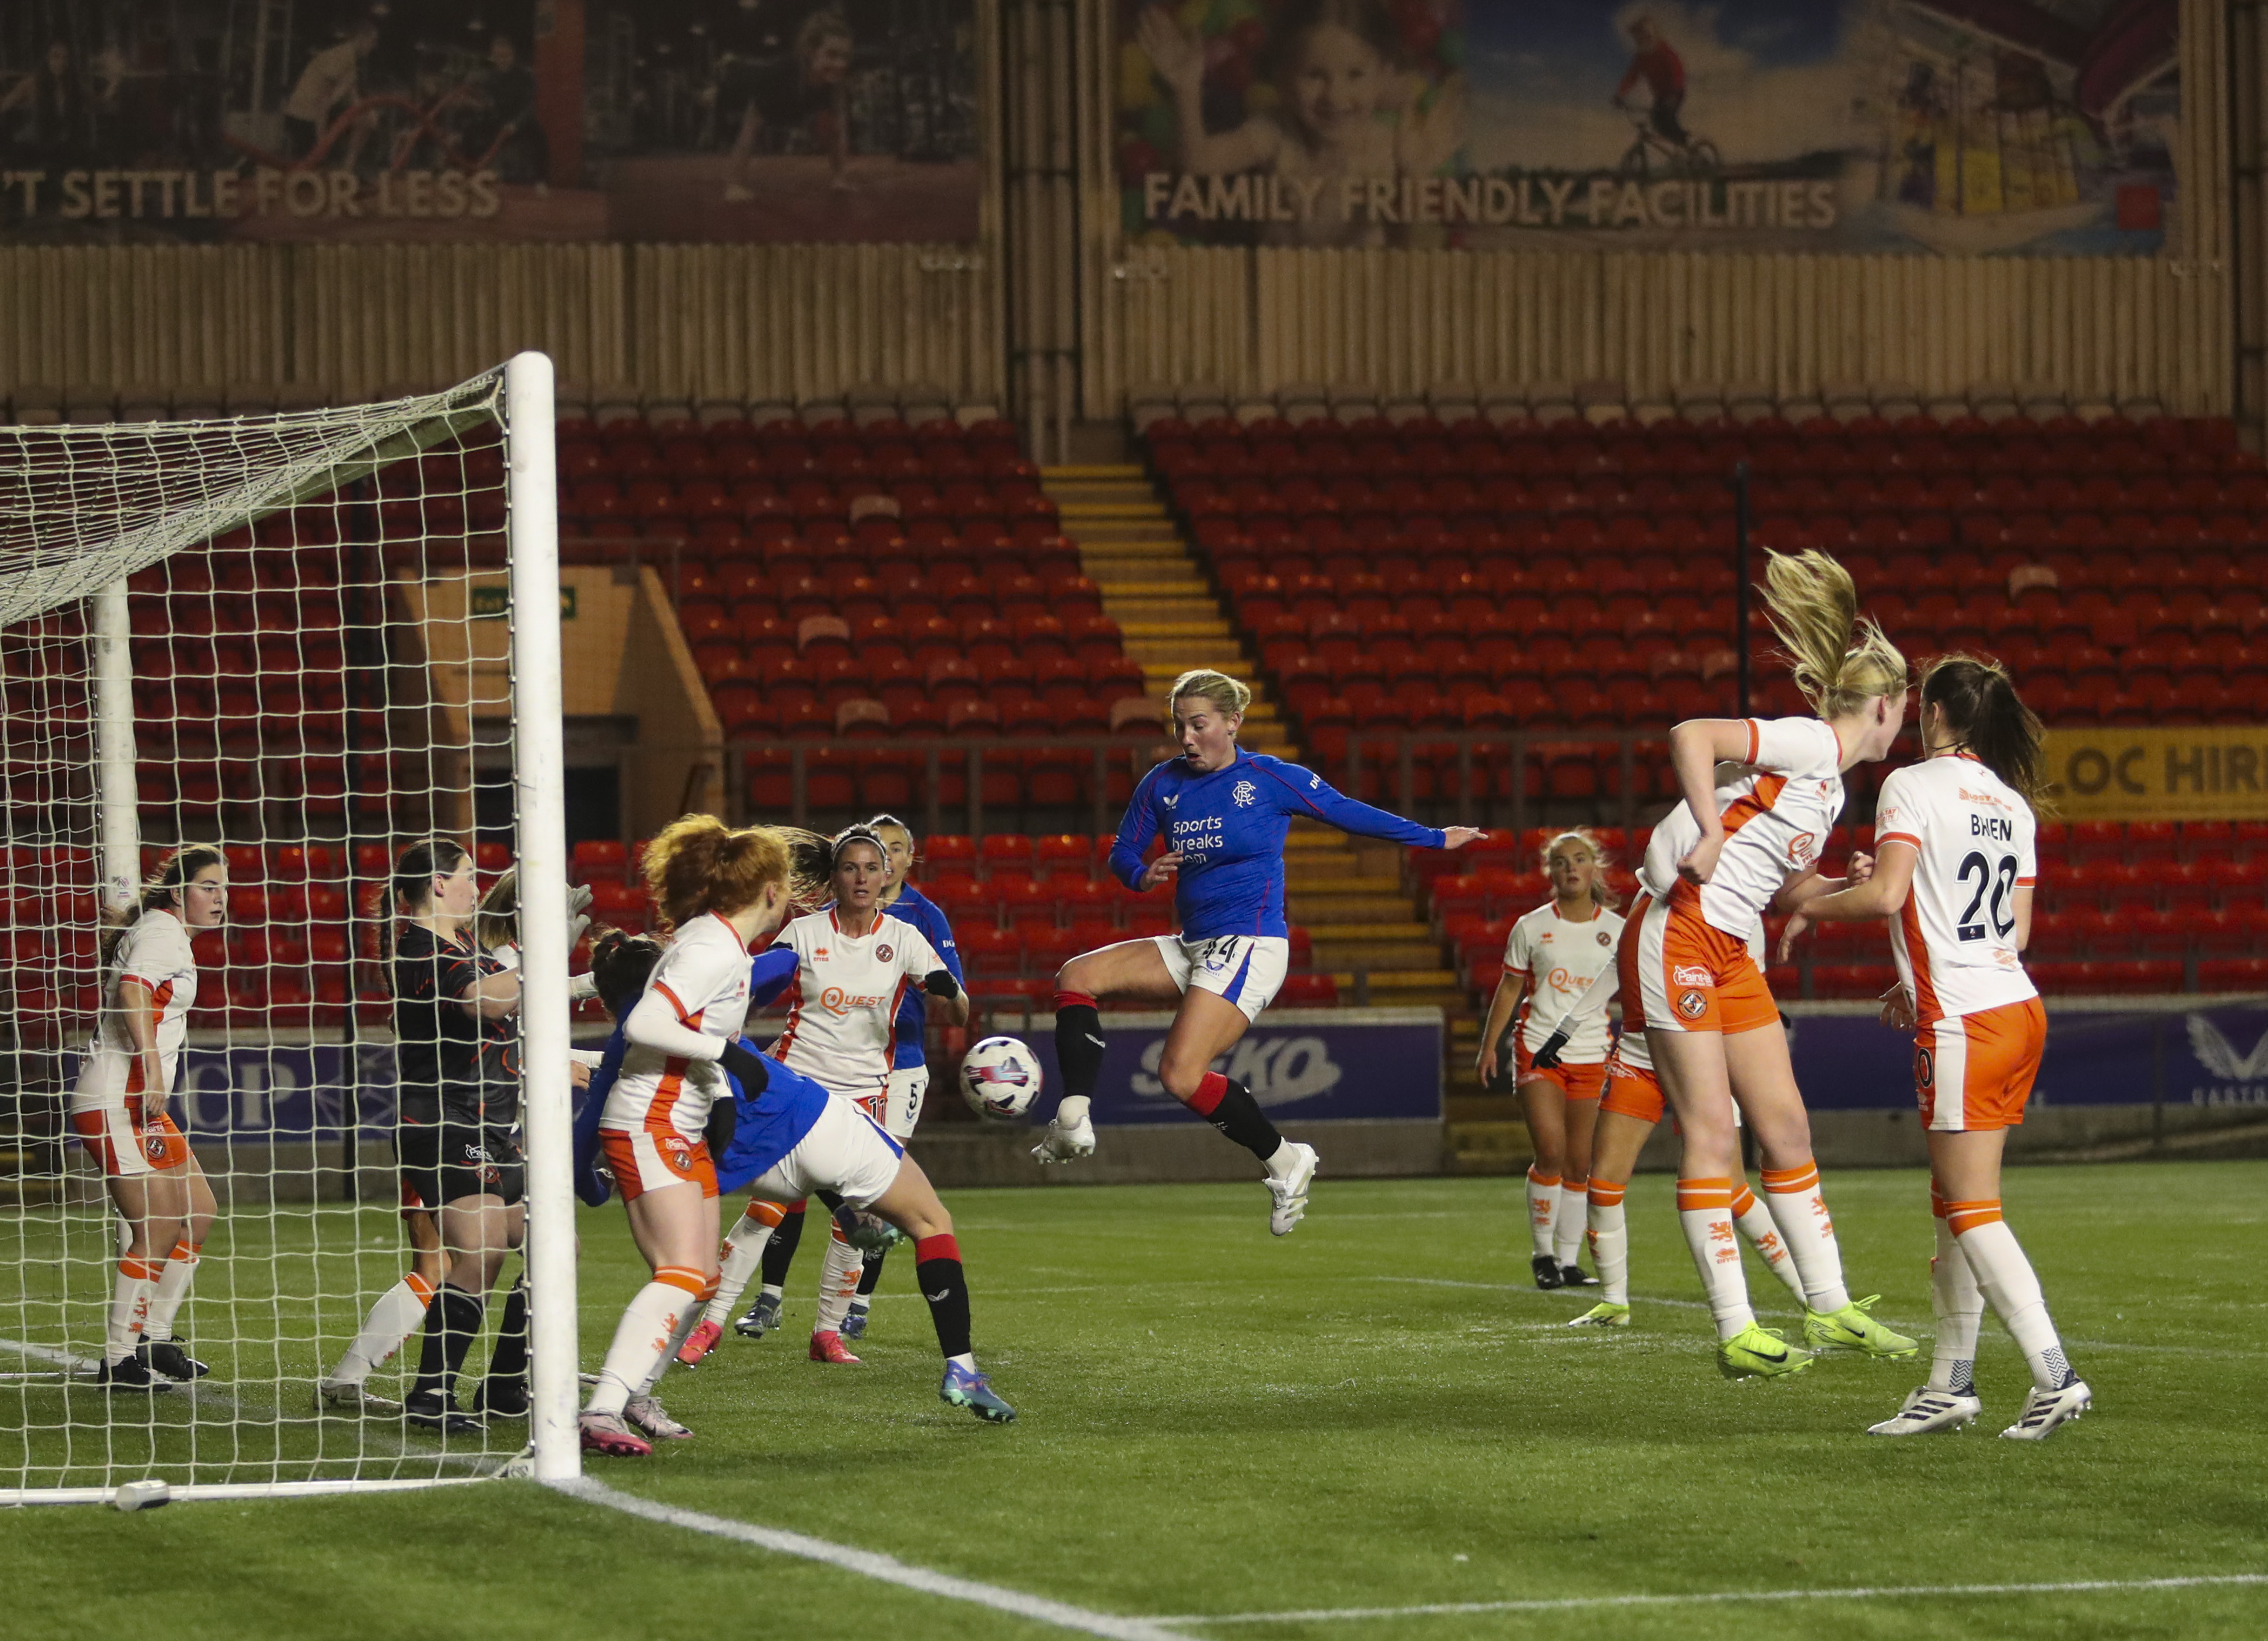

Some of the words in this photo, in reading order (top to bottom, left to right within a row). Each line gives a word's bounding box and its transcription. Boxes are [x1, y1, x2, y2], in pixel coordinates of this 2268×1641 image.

[60, 170, 239, 220] SETTLE
[257, 170, 363, 220] FOR
[379, 170, 503, 219] LESS
[1144, 172, 1322, 222] FAMILY
[1340, 175, 1571, 227] FRIENDLY
[1588, 177, 1836, 230] FACILITIES
[2165, 744, 2268, 794] HIR
[1172, 816, 1222, 835] sports
[1172, 833, 1223, 852] breaks
[1955, 849, 2018, 942] 20
[1548, 968, 1595, 994] QUES
[820, 987, 885, 1015] QUEST
[909, 1083, 917, 1110] 5
